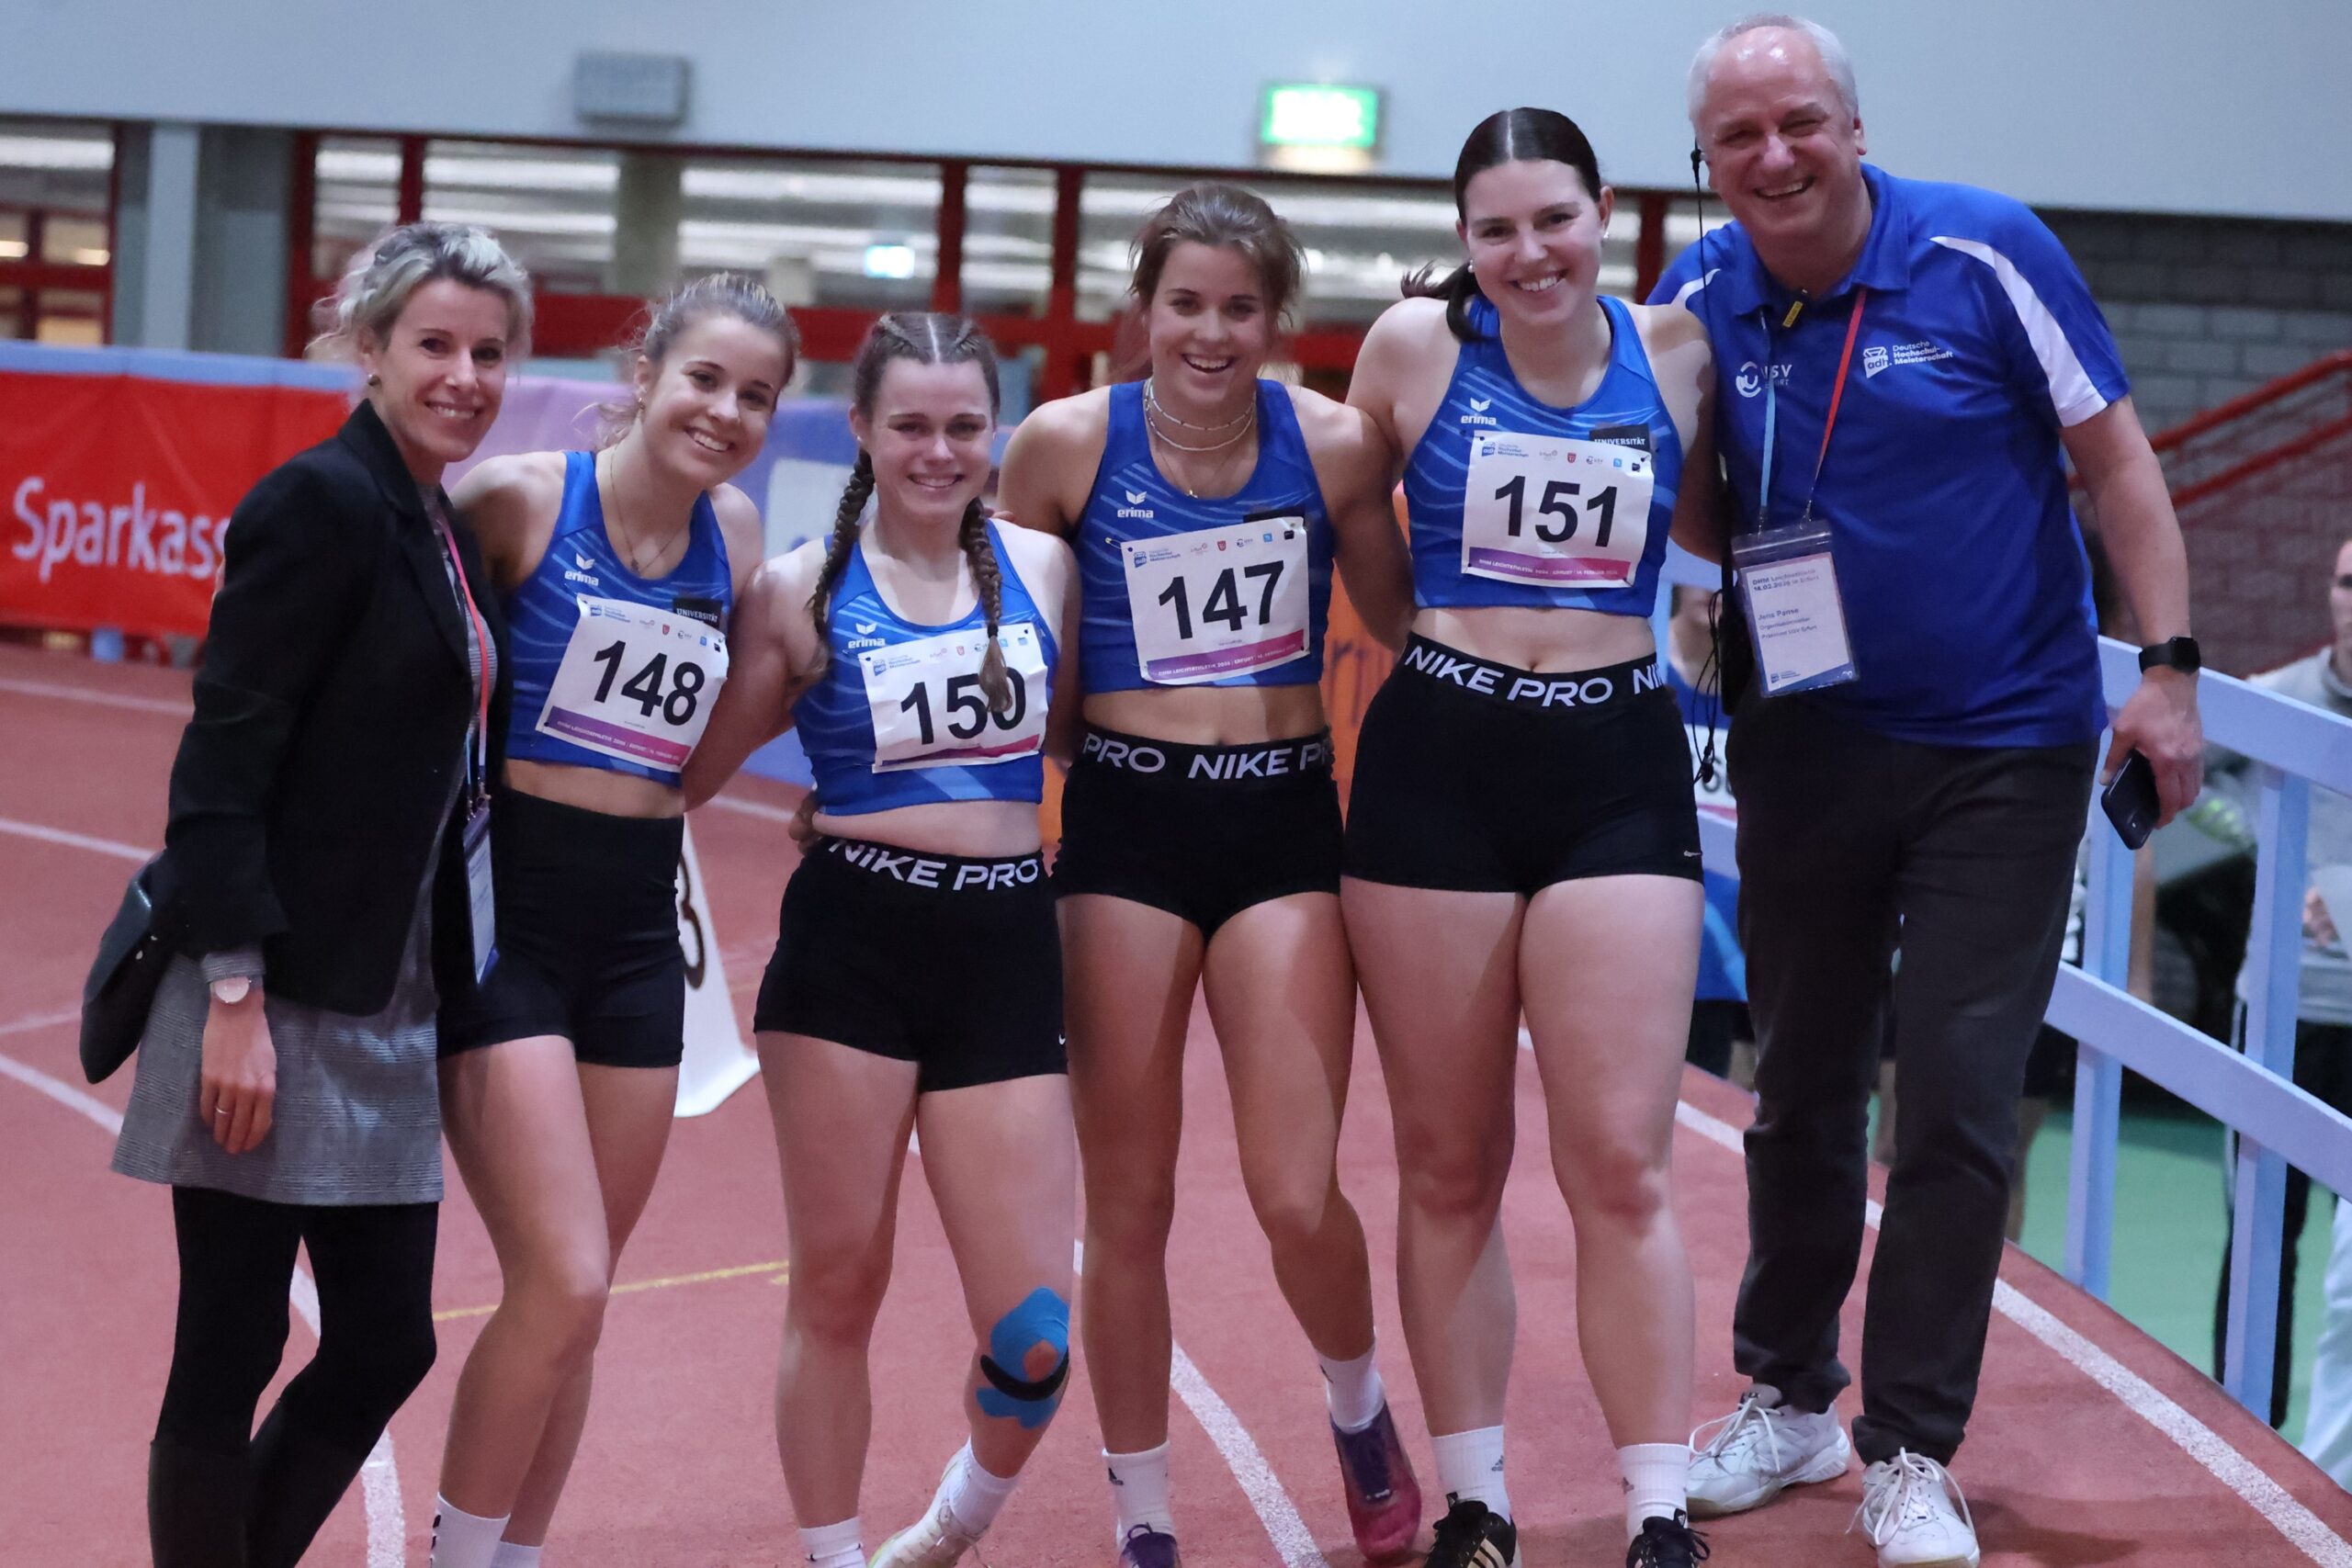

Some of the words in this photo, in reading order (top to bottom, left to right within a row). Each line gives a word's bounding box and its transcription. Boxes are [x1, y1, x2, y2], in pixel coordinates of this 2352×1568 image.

[1892, 340, 1929, 351] Deutsche
[1894, 350, 1952, 365] Meisterschaft
[1461, 414, 1497, 425] erima
[1117, 507, 1154, 518] erima
[1495, 476, 1617, 547] 151
[564, 570, 599, 586] erima
[1159, 560, 1284, 639] 147
[676, 608, 718, 623] UNIVERSITÄT
[848, 637, 887, 649] erima
[594, 640, 705, 726] 148
[1405, 645, 1505, 694] NIKE
[1507, 677, 1613, 706] PRO
[901, 667, 1026, 745] 150
[1082, 733, 1166, 773] PRO
[1188, 748, 1293, 780] NIKE
[829, 839, 947, 888] NIKE
[953, 859, 1039, 890] PRO
